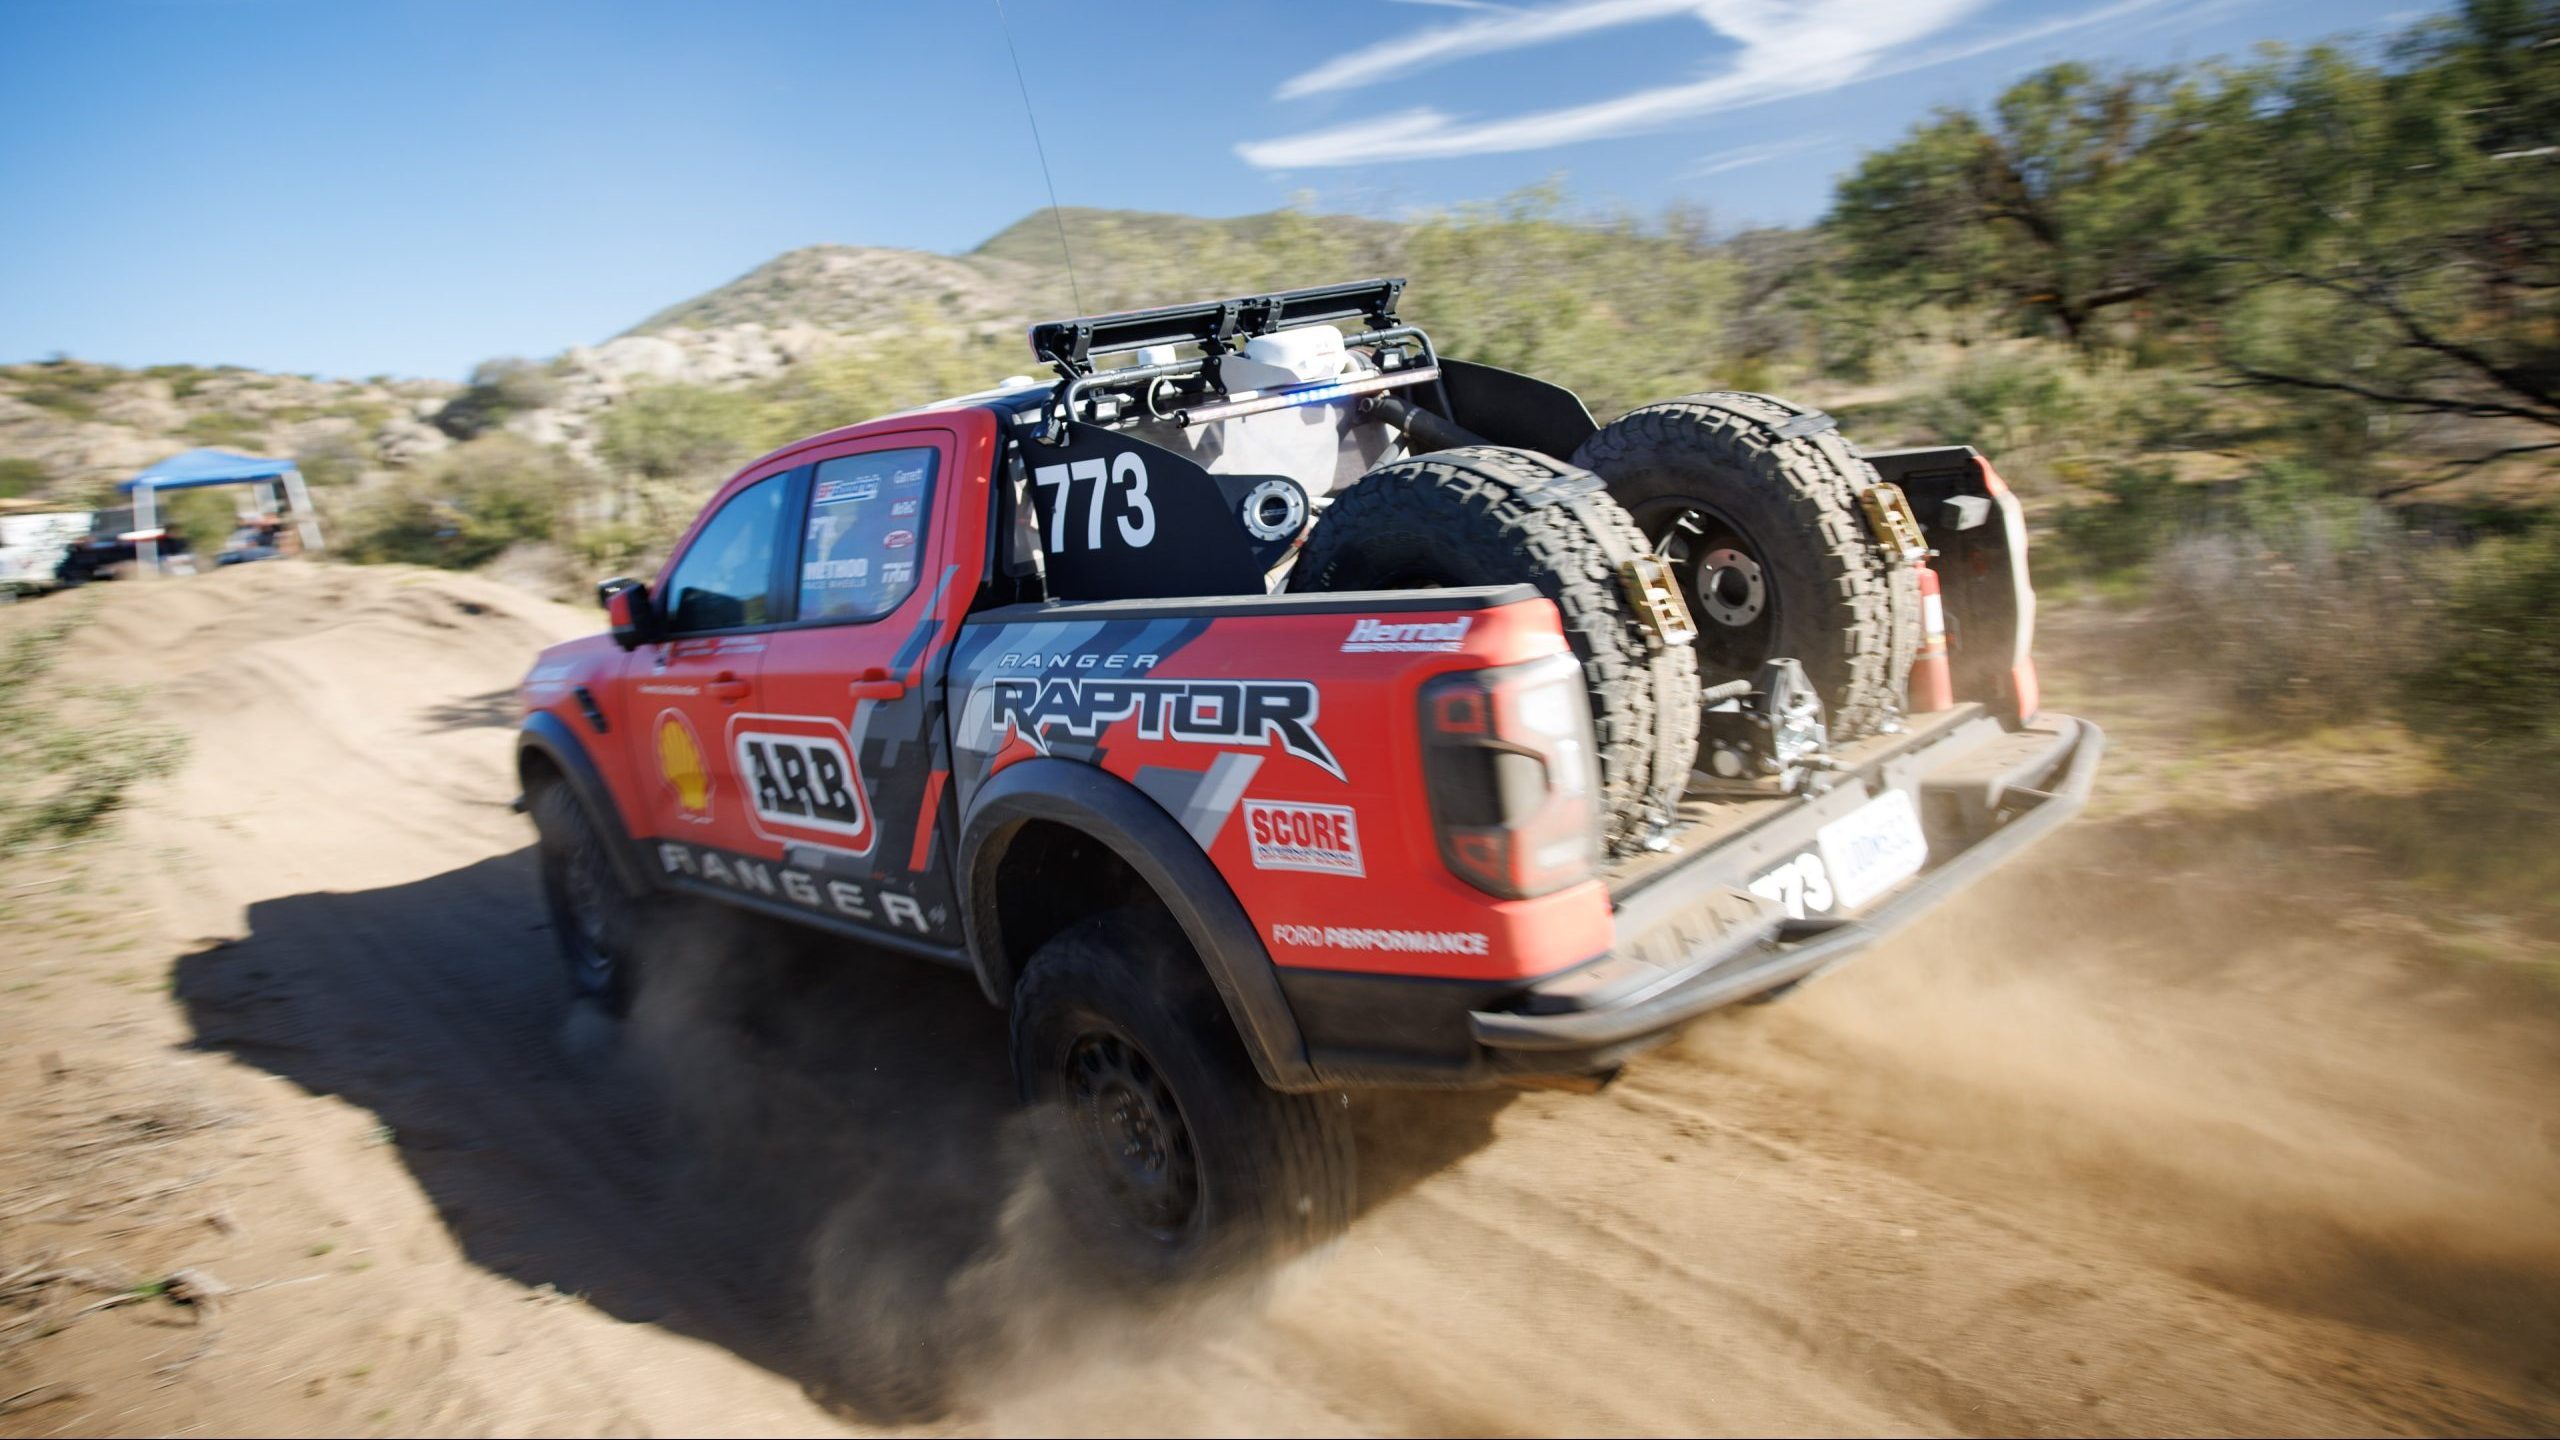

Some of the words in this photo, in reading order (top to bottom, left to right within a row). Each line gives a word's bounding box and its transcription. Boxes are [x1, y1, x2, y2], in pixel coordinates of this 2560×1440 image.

[1034, 451, 1156, 554] 773
[803, 559, 868, 579] METHOD
[1346, 616, 1473, 642] Herrod
[998, 653, 1159, 669] RANGER
[991, 677, 1348, 784] RAPTOR
[745, 740, 858, 825] ARB
[1252, 808, 1352, 852] SCORE
[659, 843, 930, 933] RANGER
[1272, 924, 1323, 947] FORD
[1324, 927, 1489, 955] PERFORMANCE
